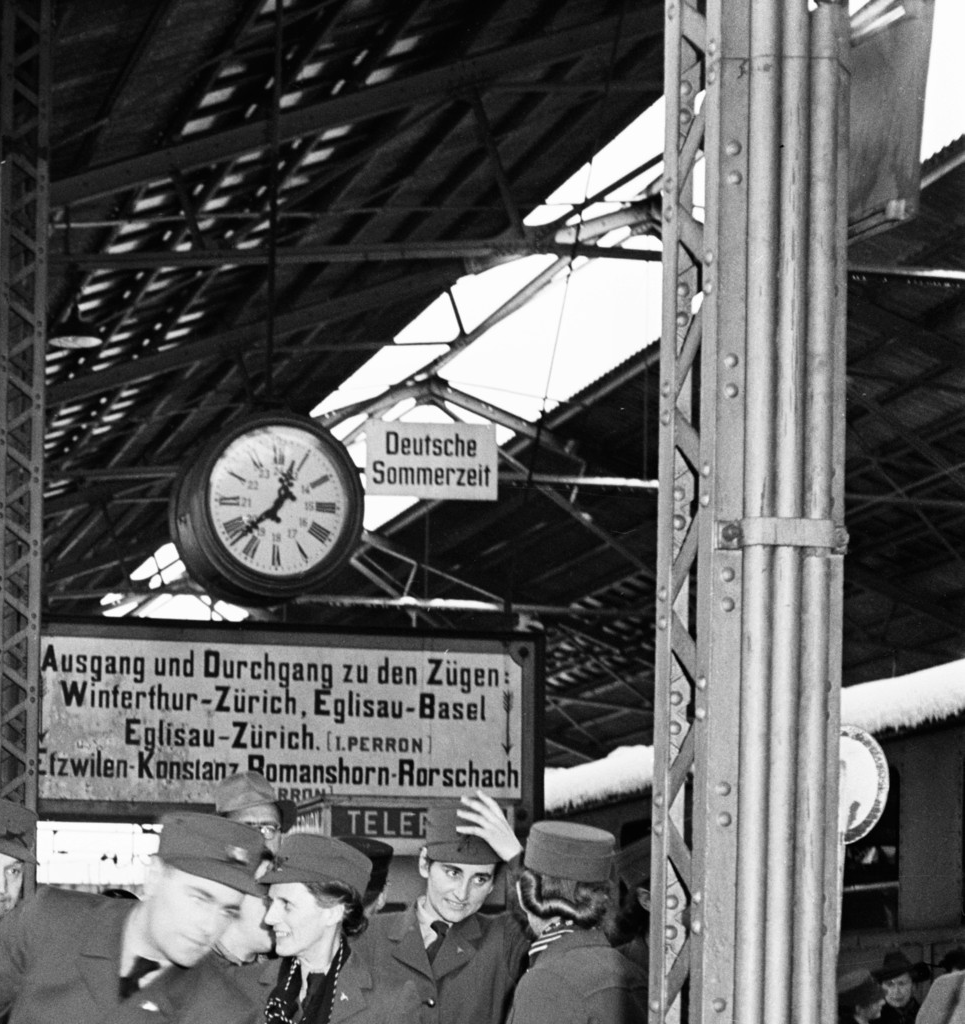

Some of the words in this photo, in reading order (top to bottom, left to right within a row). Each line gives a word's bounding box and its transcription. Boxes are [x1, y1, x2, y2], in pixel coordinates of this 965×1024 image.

[386, 431, 477, 458] Deutsche
[372, 461, 491, 487] Sommerzeit
[41, 644, 145, 683] Ausgang
[154, 650, 194, 677] und
[204, 650, 333, 689] Durchgang
[342, 664, 368, 683] zu
[377, 657, 417, 685] den
[427, 658, 509, 694] Zügen:
[61, 680, 306, 717] Winterthur-Zürich,
[314, 689, 486, 724] Eglisau-Basel
[125, 718, 320, 752] Eglisau-Zürich.
[248, 754, 519, 788] Romanshorn-Rorschach
